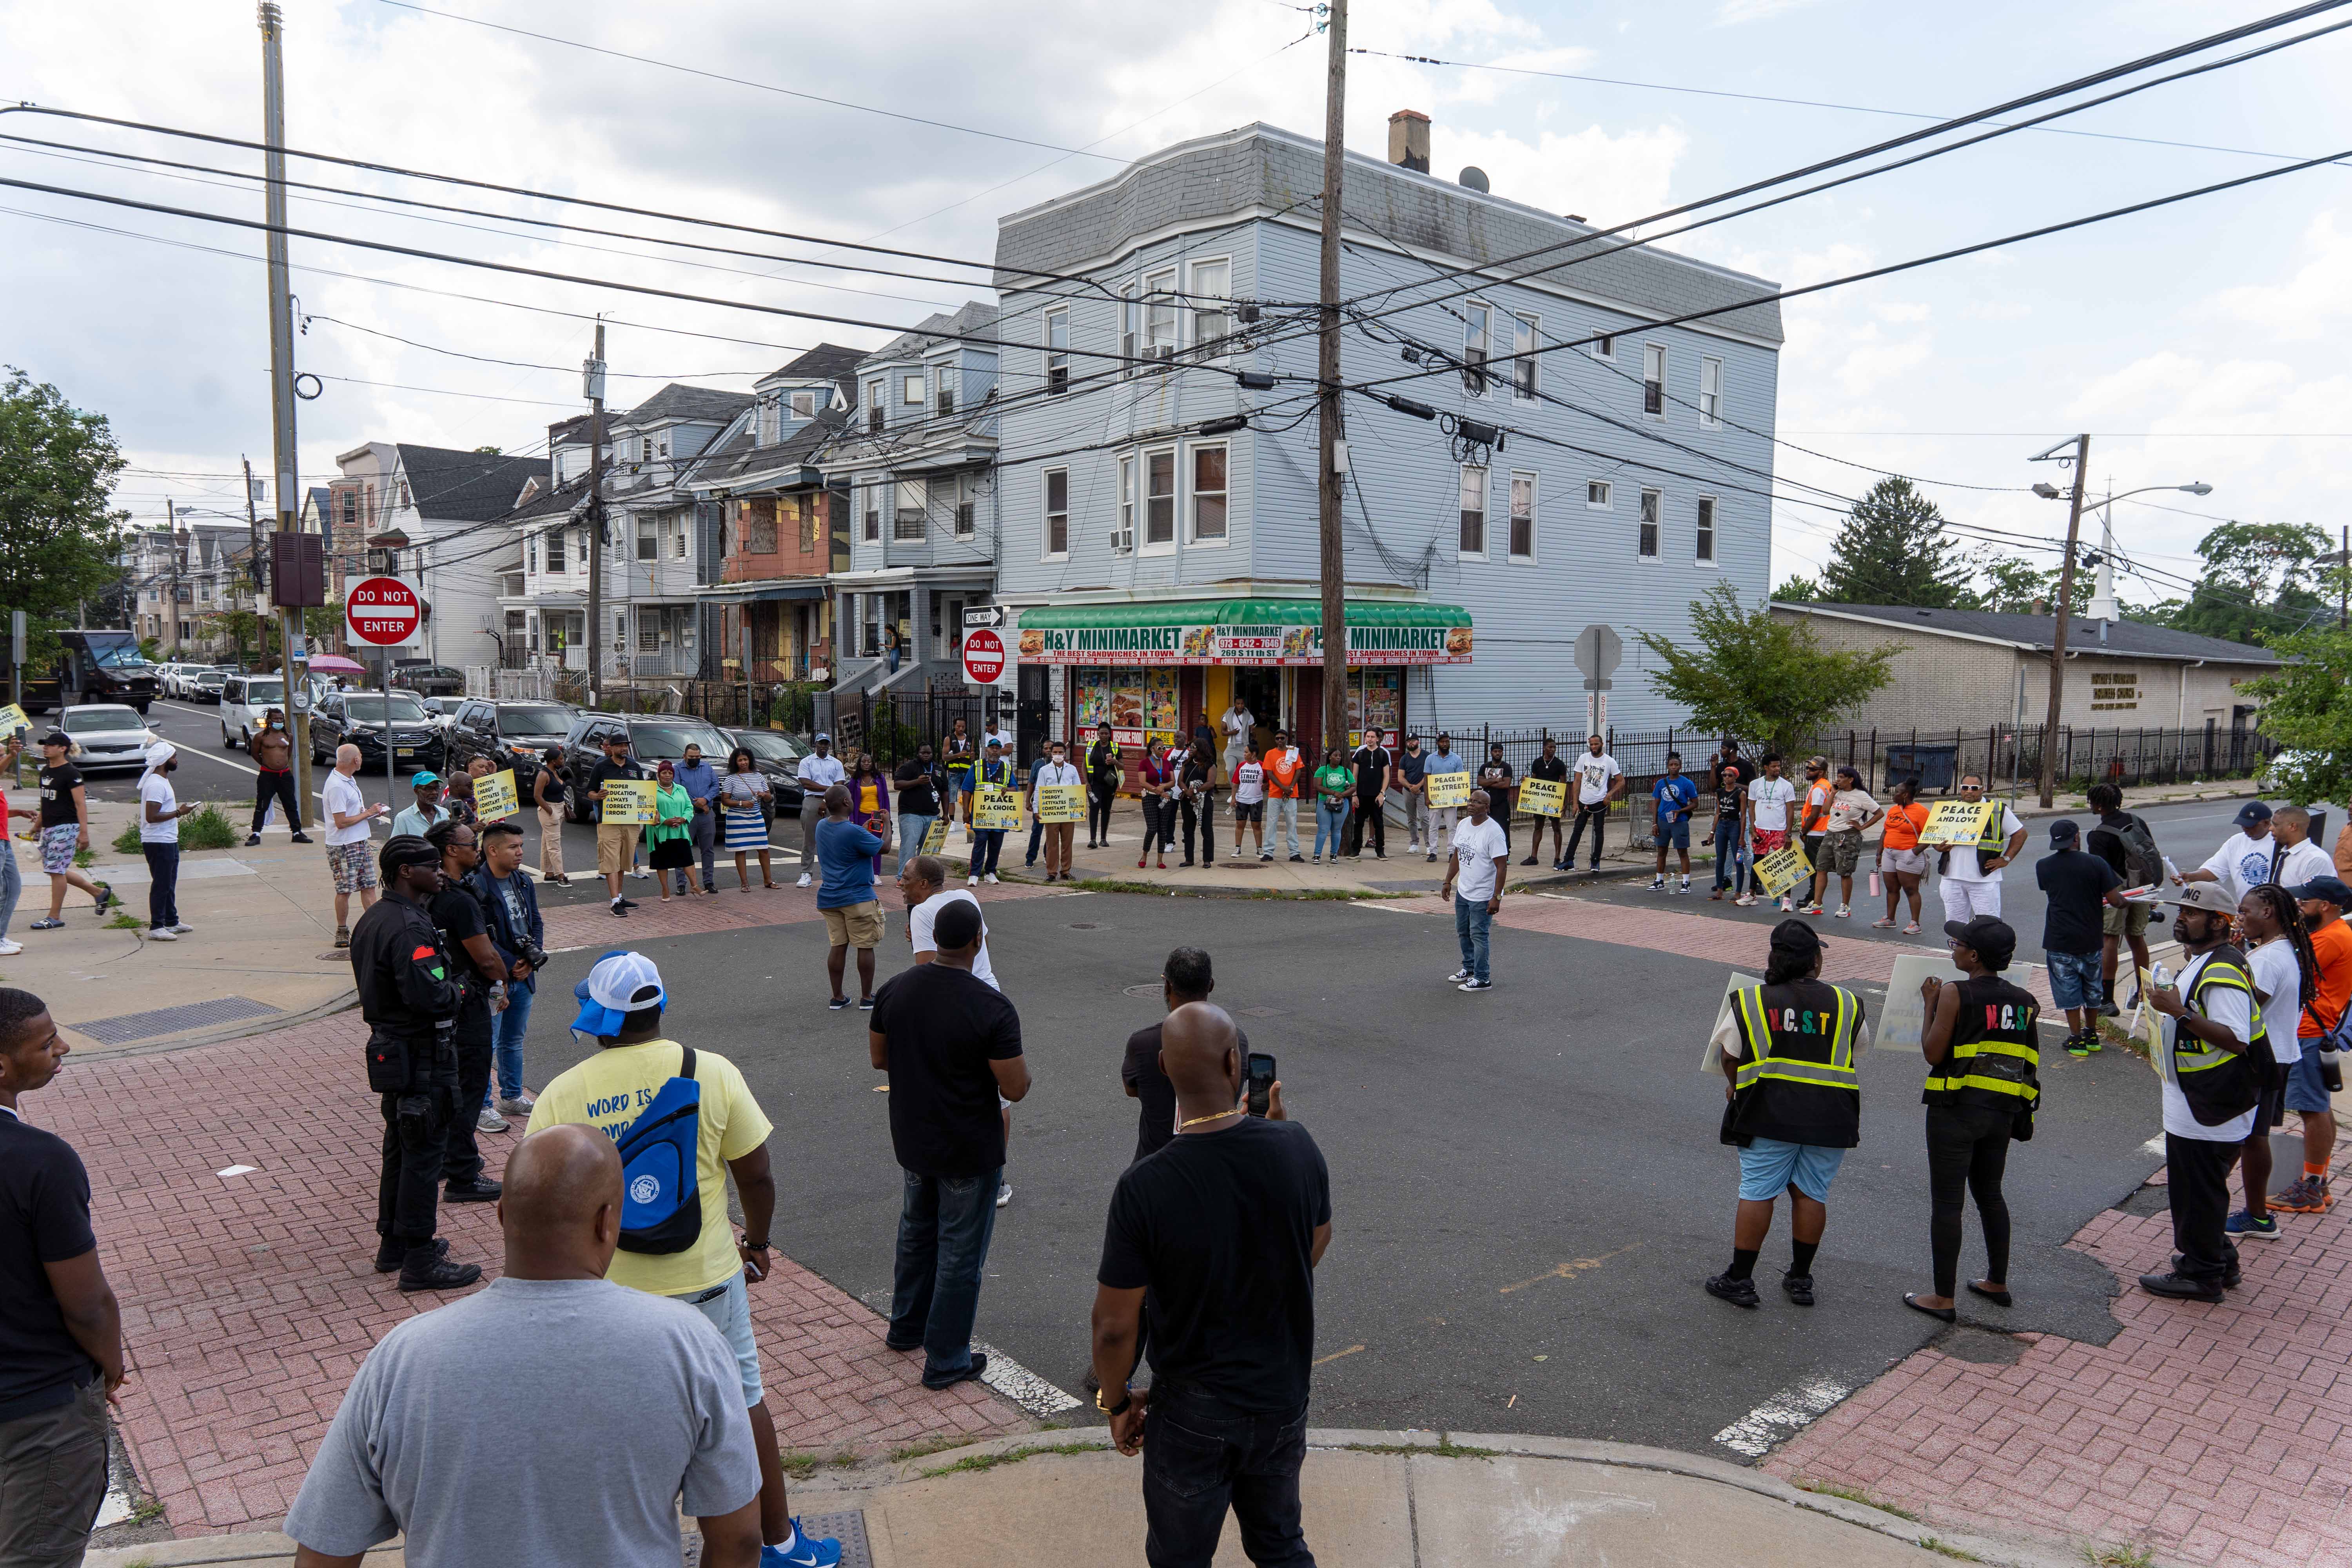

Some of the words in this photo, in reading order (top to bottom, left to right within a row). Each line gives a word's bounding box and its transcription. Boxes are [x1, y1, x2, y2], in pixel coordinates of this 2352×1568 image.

[358, 590, 376, 602] DO
[383, 591, 409, 602] NOT
[967, 614, 978, 622] ONE
[980, 613, 991, 621] WAY
[363, 621, 405, 632] ENTER
[1217, 626, 1231, 636] H&Y
[1232, 626, 1283, 637] MINIMARKET
[1044, 630, 1075, 650] H&Y
[1078, 627, 1182, 650] MINIMARKET
[1220, 639, 1233, 648] 973
[1239, 639, 1255, 648] 642
[1260, 639, 1280, 648] 7646
[1351, 628, 1447, 650] MINIMARKET
[970, 639, 980, 648] DO
[984, 641, 999, 650] NOT
[973, 664, 996, 673] ENTER
[1113, 730, 1131, 743] HISPANIC
[1132, 731, 1142, 744] FOOD
[1380, 733, 1394, 745] ARDS
[476, 779, 495, 788] POSITIVE
[1442, 782, 1469, 791] STREETS
[1530, 782, 1557, 792] PEACE
[477, 786, 494, 795] ENERGY
[479, 791, 499, 802] ACTIVATES
[984, 795, 1014, 803] PEACE
[479, 798, 500, 808] CONSTANT
[480, 804, 503, 815] ELEVATION
[1940, 806, 1982, 814] PEACE
[1762, 854, 1779, 866] DRIVE
[1762, 859, 1782, 875] YOUR
[1781, 849, 1798, 863] KIDS
[1771, 867, 1784, 878] LIVE
[1783, 859, 1797, 870] HERE
[1772, 882, 1791, 896] COLLECTIVE
[586, 1094, 629, 1118] WORD
[635, 1088, 653, 1107] IS
